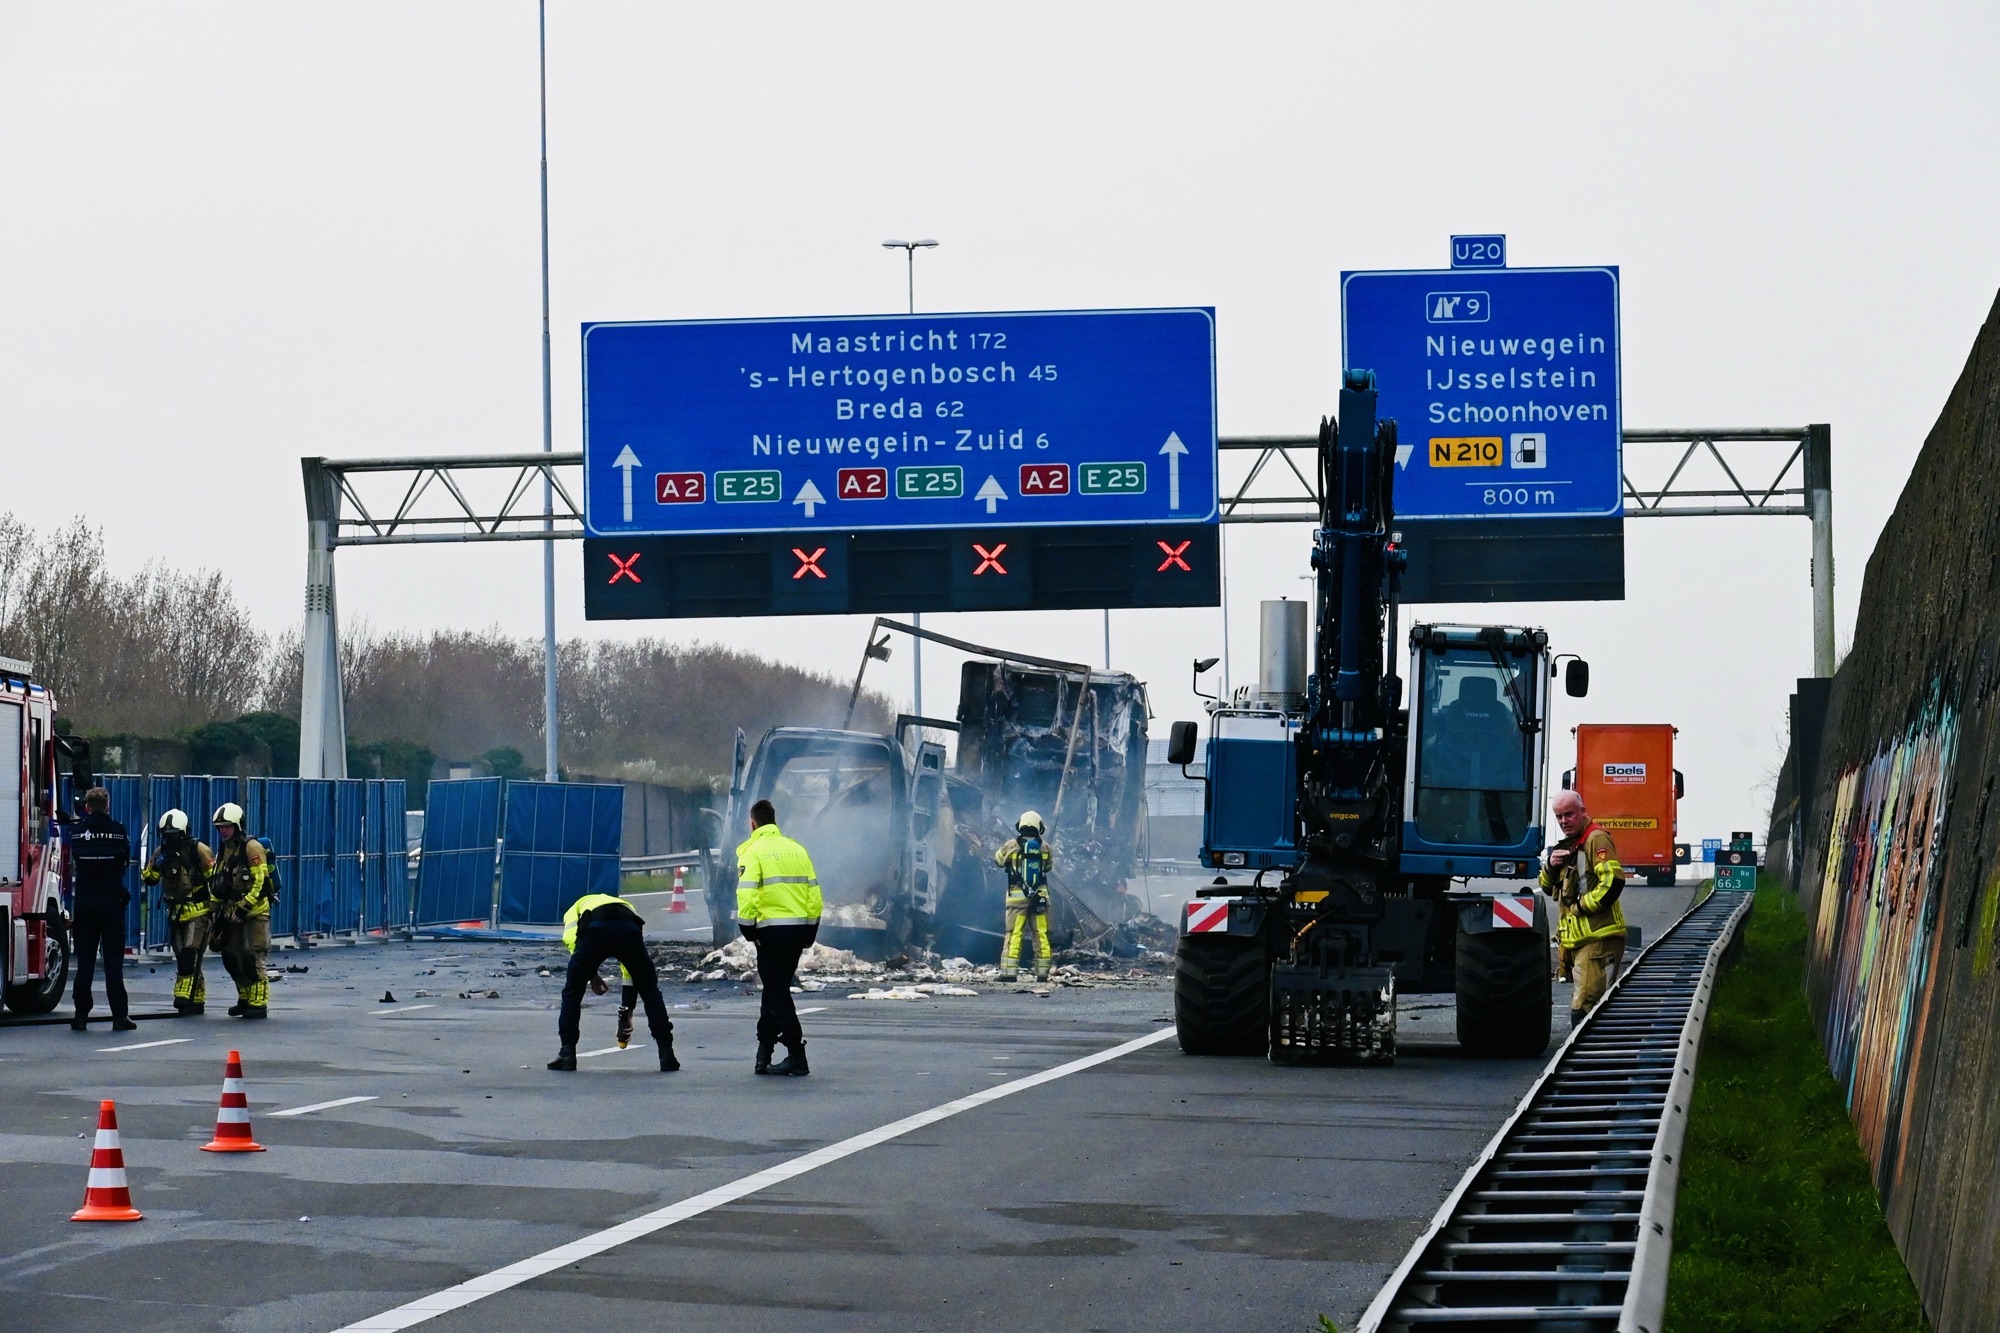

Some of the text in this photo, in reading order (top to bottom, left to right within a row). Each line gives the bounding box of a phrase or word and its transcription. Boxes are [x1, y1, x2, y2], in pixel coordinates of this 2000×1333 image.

[1455, 243, 1501, 260] U20
[1466, 299, 1480, 315] 9
[791, 330, 1007, 354] Maastricht 172
[1426, 333, 1605, 361] Nieuwegein
[1028, 365, 1058, 382] 45
[1427, 367, 1596, 390] IJsselstein
[836, 398, 964, 420] Breda 62
[1428, 401, 1608, 424] Schoonhoven
[1036, 433, 1049, 449] 6
[662, 479, 699, 498] A2
[843, 474, 881, 493] A2
[1026, 470, 1064, 489] A2
[1483, 488, 1555, 506] 800 m
[1605, 765, 1644, 775] Boels
[1329, 812, 1360, 821] engcon
[1597, 819, 1653, 828] werkverkeer
[80, 831, 113, 840] POLITIE
